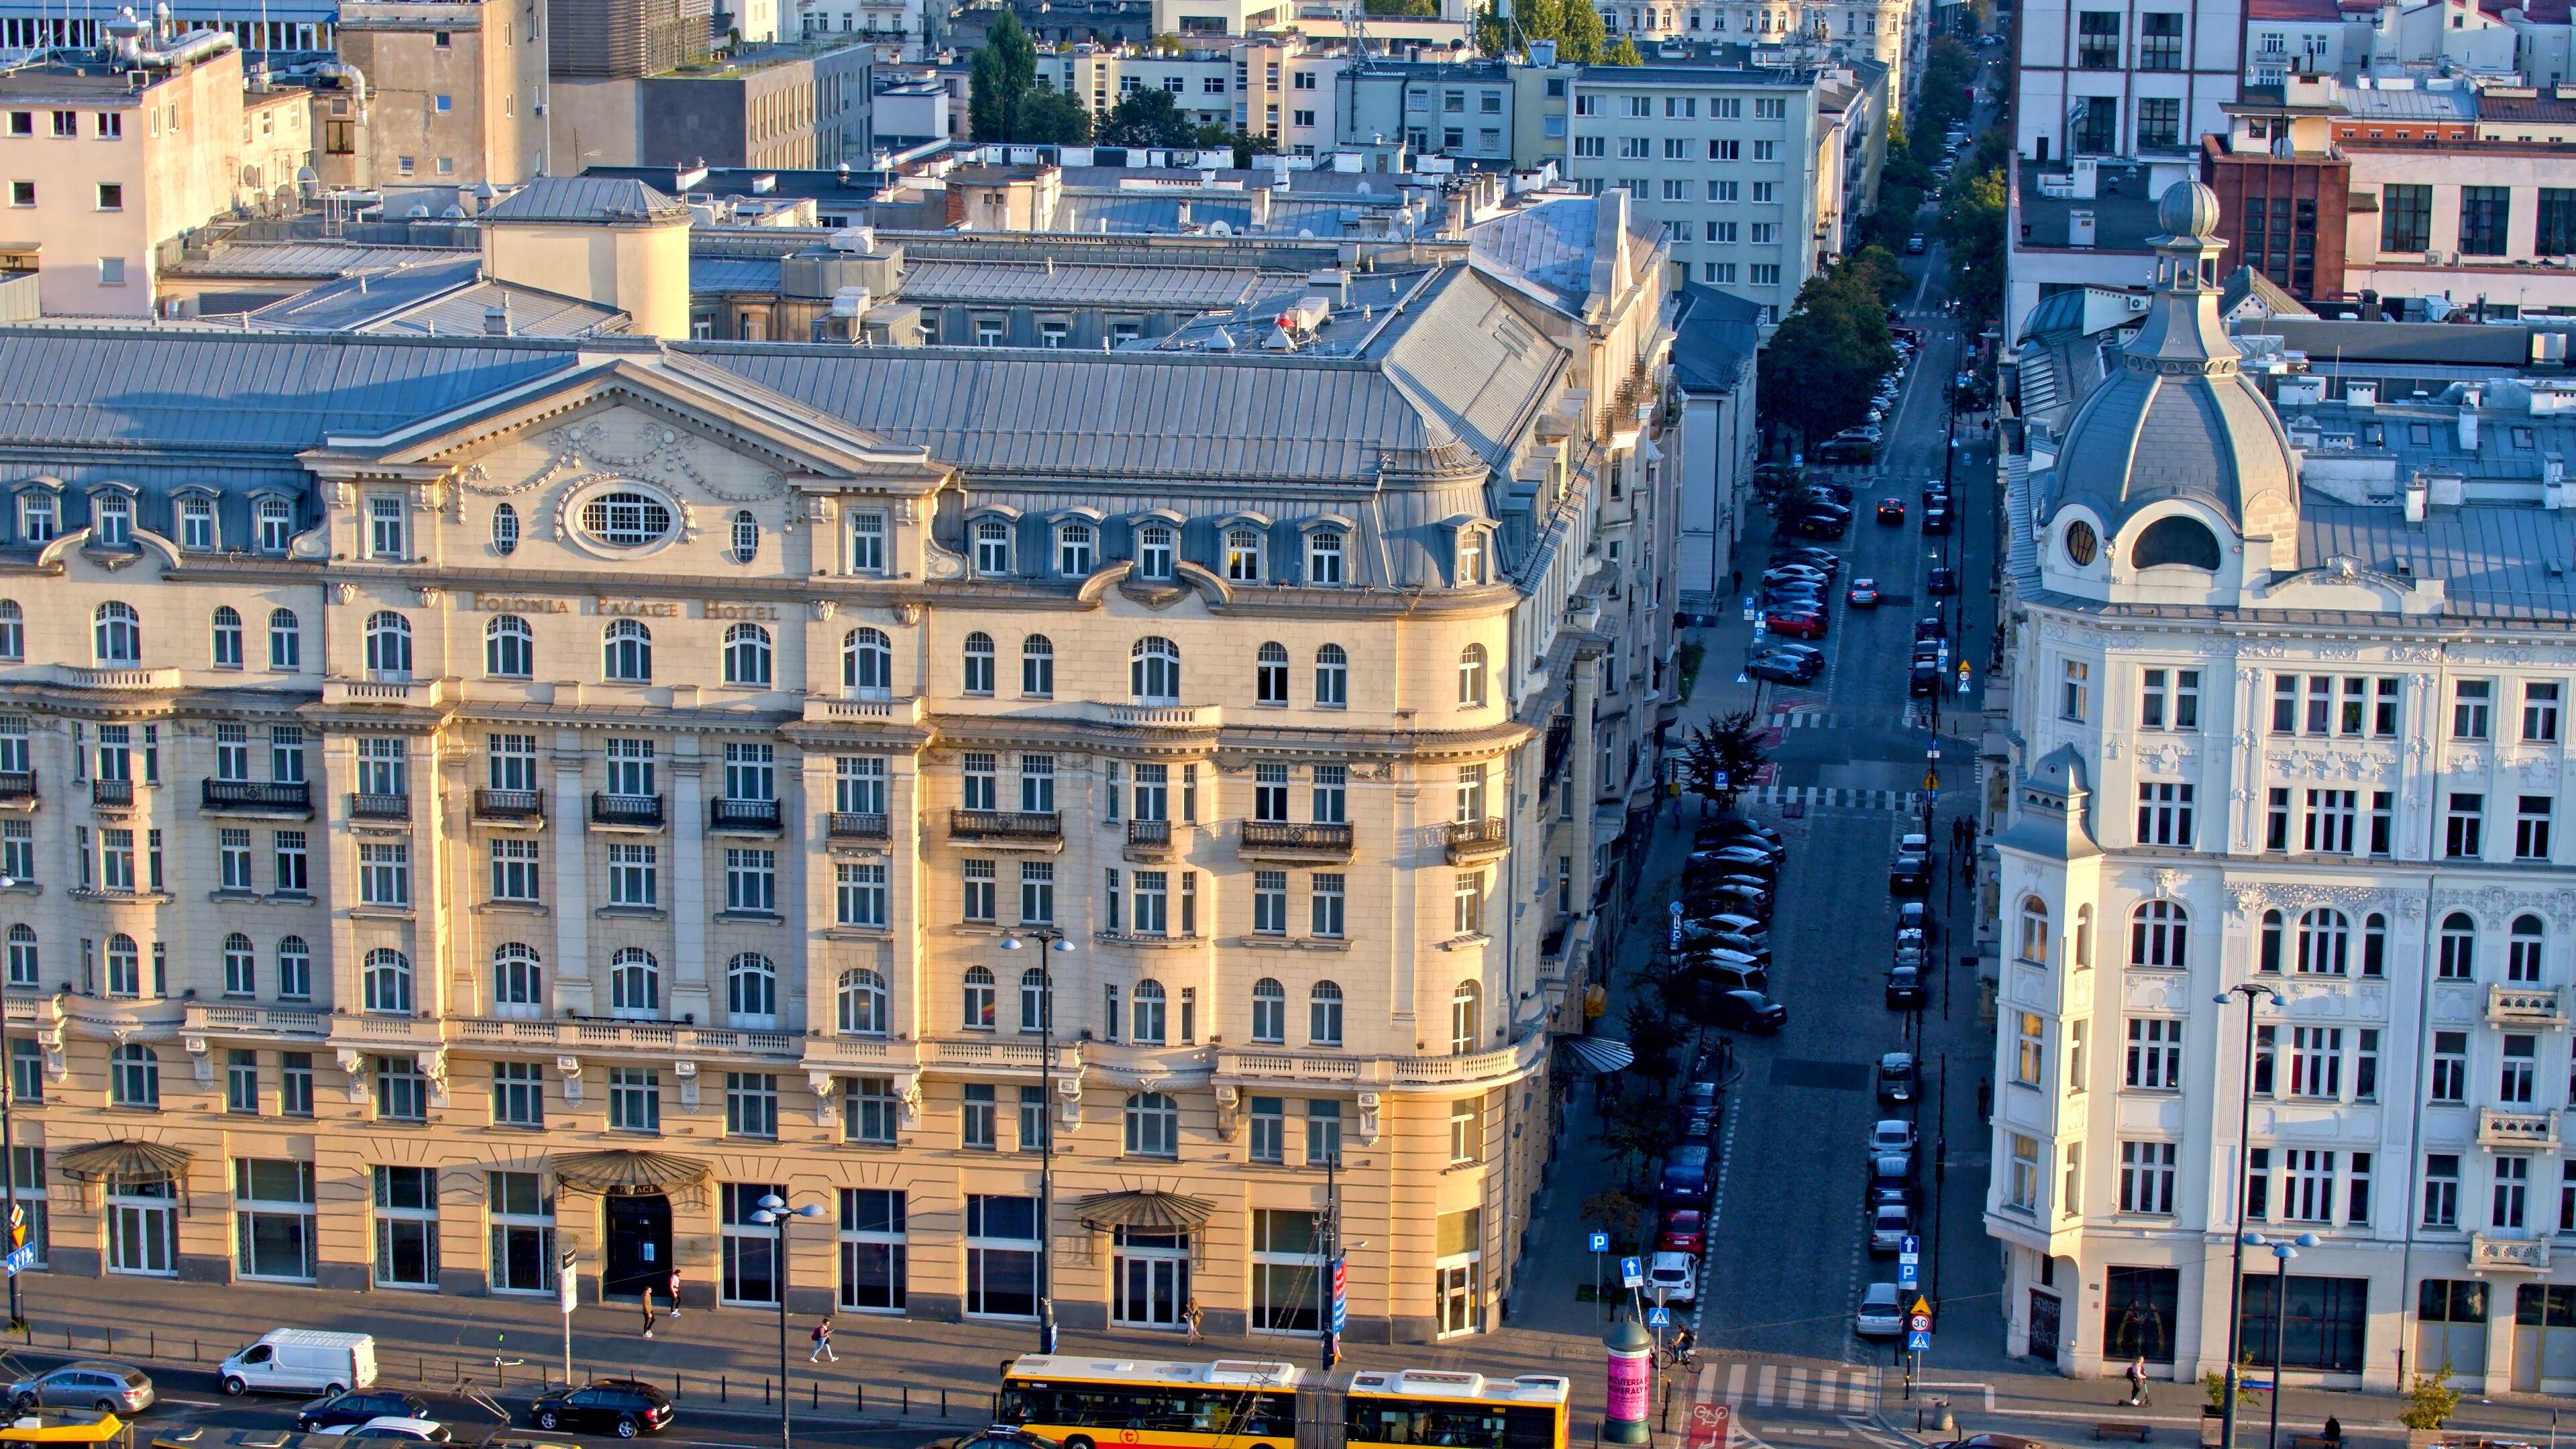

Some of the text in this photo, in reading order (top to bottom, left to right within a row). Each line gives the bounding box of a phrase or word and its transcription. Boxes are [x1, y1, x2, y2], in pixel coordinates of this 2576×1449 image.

[474, 592, 780, 620] POLONIA PALACE HOTEL
[1747, 598, 1753, 606] P
[1757, 629, 1764, 637] P
[1939, 657, 1945, 665] P
[1718, 773, 1725, 782] P
[1673, 930, 1681, 941] P
[1595, 1236, 1604, 1248] P
[1903, 1266, 1914, 1279] P
[1914, 1319, 1927, 1328] 30
[1124, 1432, 1134, 1442] t
